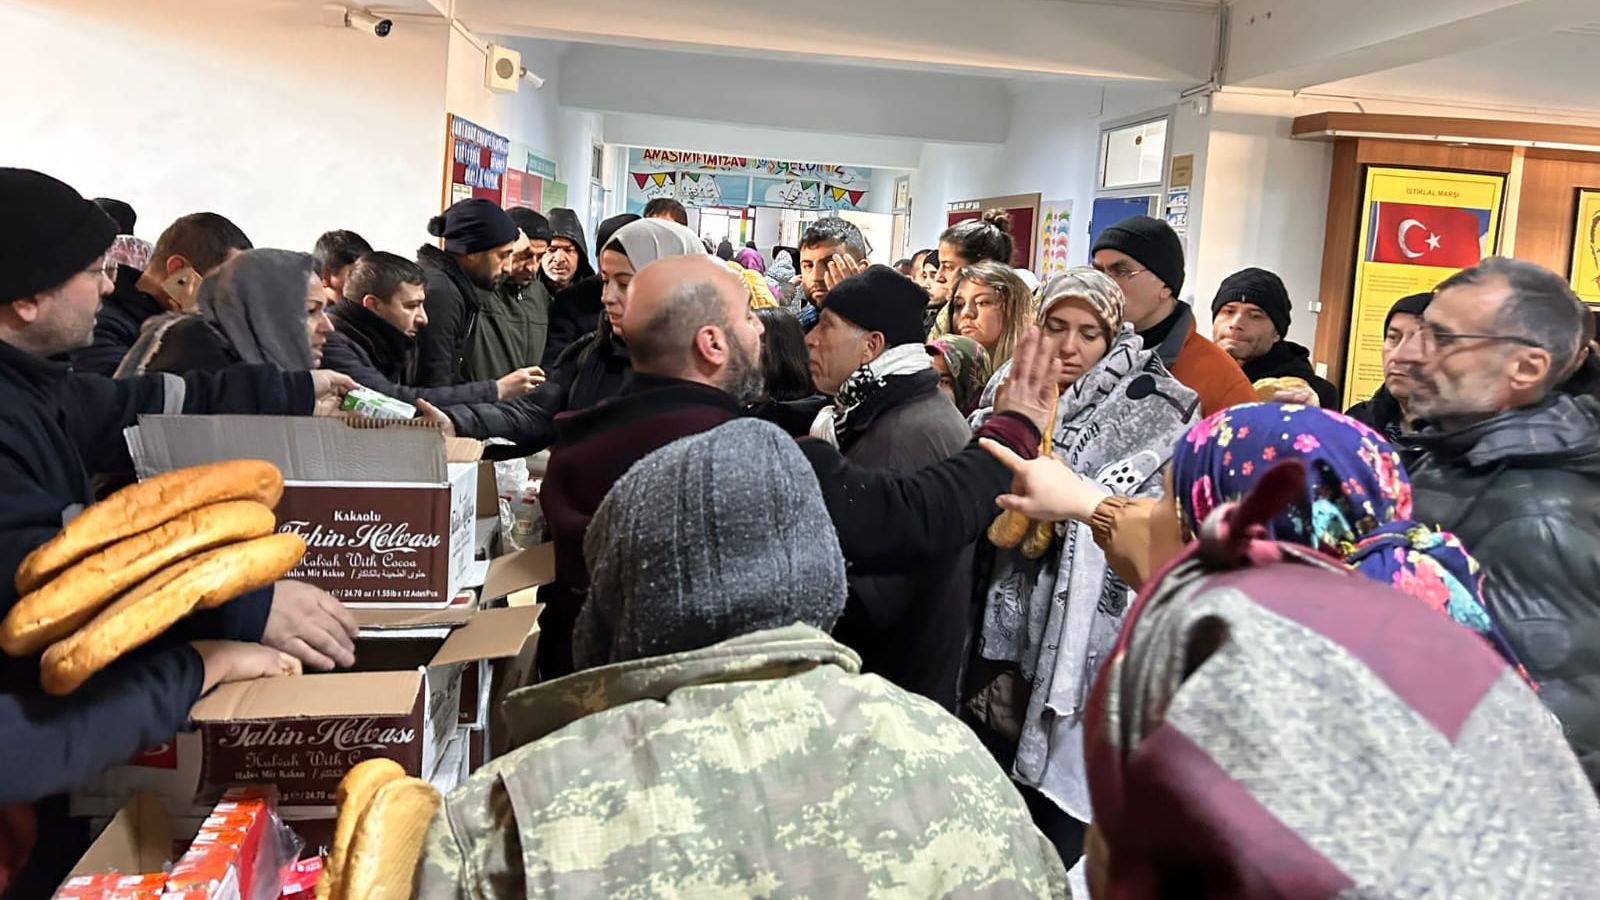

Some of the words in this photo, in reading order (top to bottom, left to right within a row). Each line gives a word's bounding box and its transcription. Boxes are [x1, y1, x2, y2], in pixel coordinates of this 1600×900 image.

[334, 510, 382, 521] Kakaolu
[346, 553, 377, 567] With
[382, 553, 416, 567] Cocoa
[219, 721, 306, 747] Tahin
